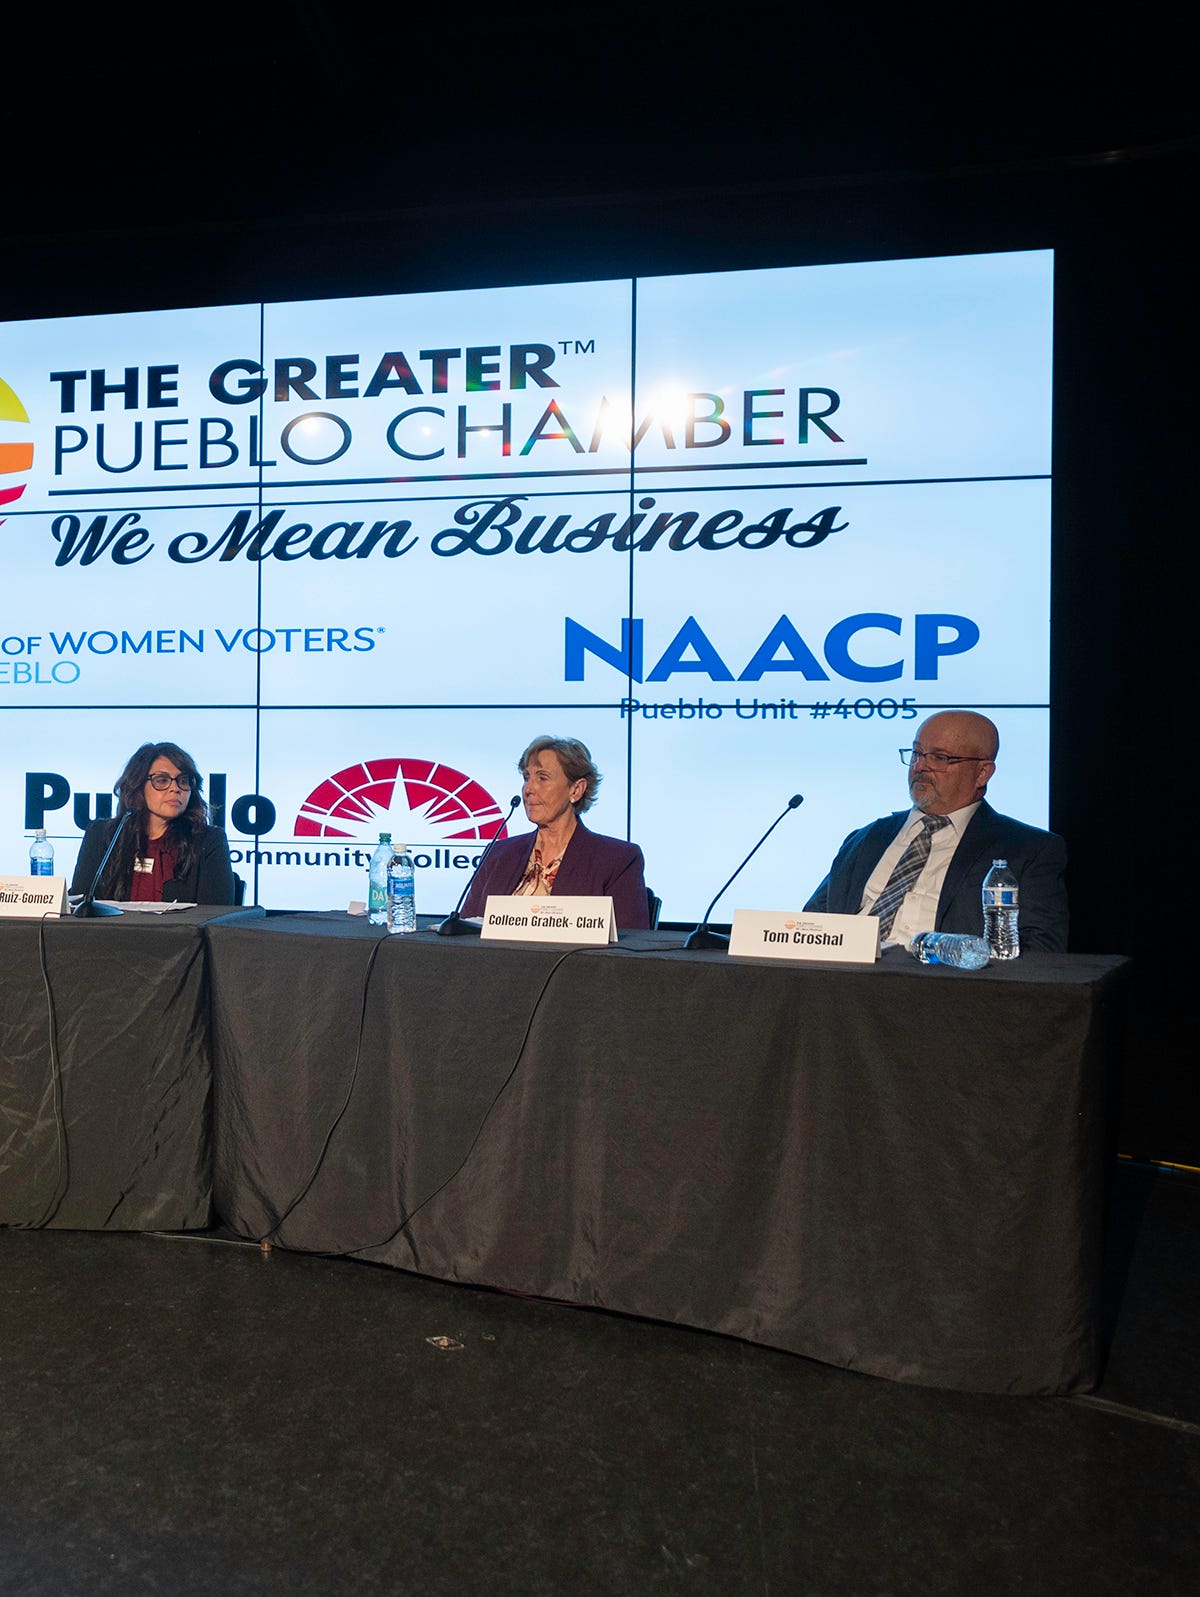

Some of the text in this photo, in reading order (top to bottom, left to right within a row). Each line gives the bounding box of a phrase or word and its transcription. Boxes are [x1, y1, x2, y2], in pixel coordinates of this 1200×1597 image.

[49, 364, 180, 414] THE
[54, 386, 846, 476] PUEBLO CHAMBER
[50, 496, 851, 568] We Mean Business
[1, 636, 43, 656] OF
[48, 629, 205, 655] WOMEN
[563, 612, 981, 685] NAACP
[619, 696, 919, 721] Pueblo Unit #4005
[24, 771, 277, 836] Pulo
[229, 847, 373, 872] ommunit
[488, 914, 604, 928] Colleen Grahek- Clark
[763, 929, 843, 946] Tom Croshal
